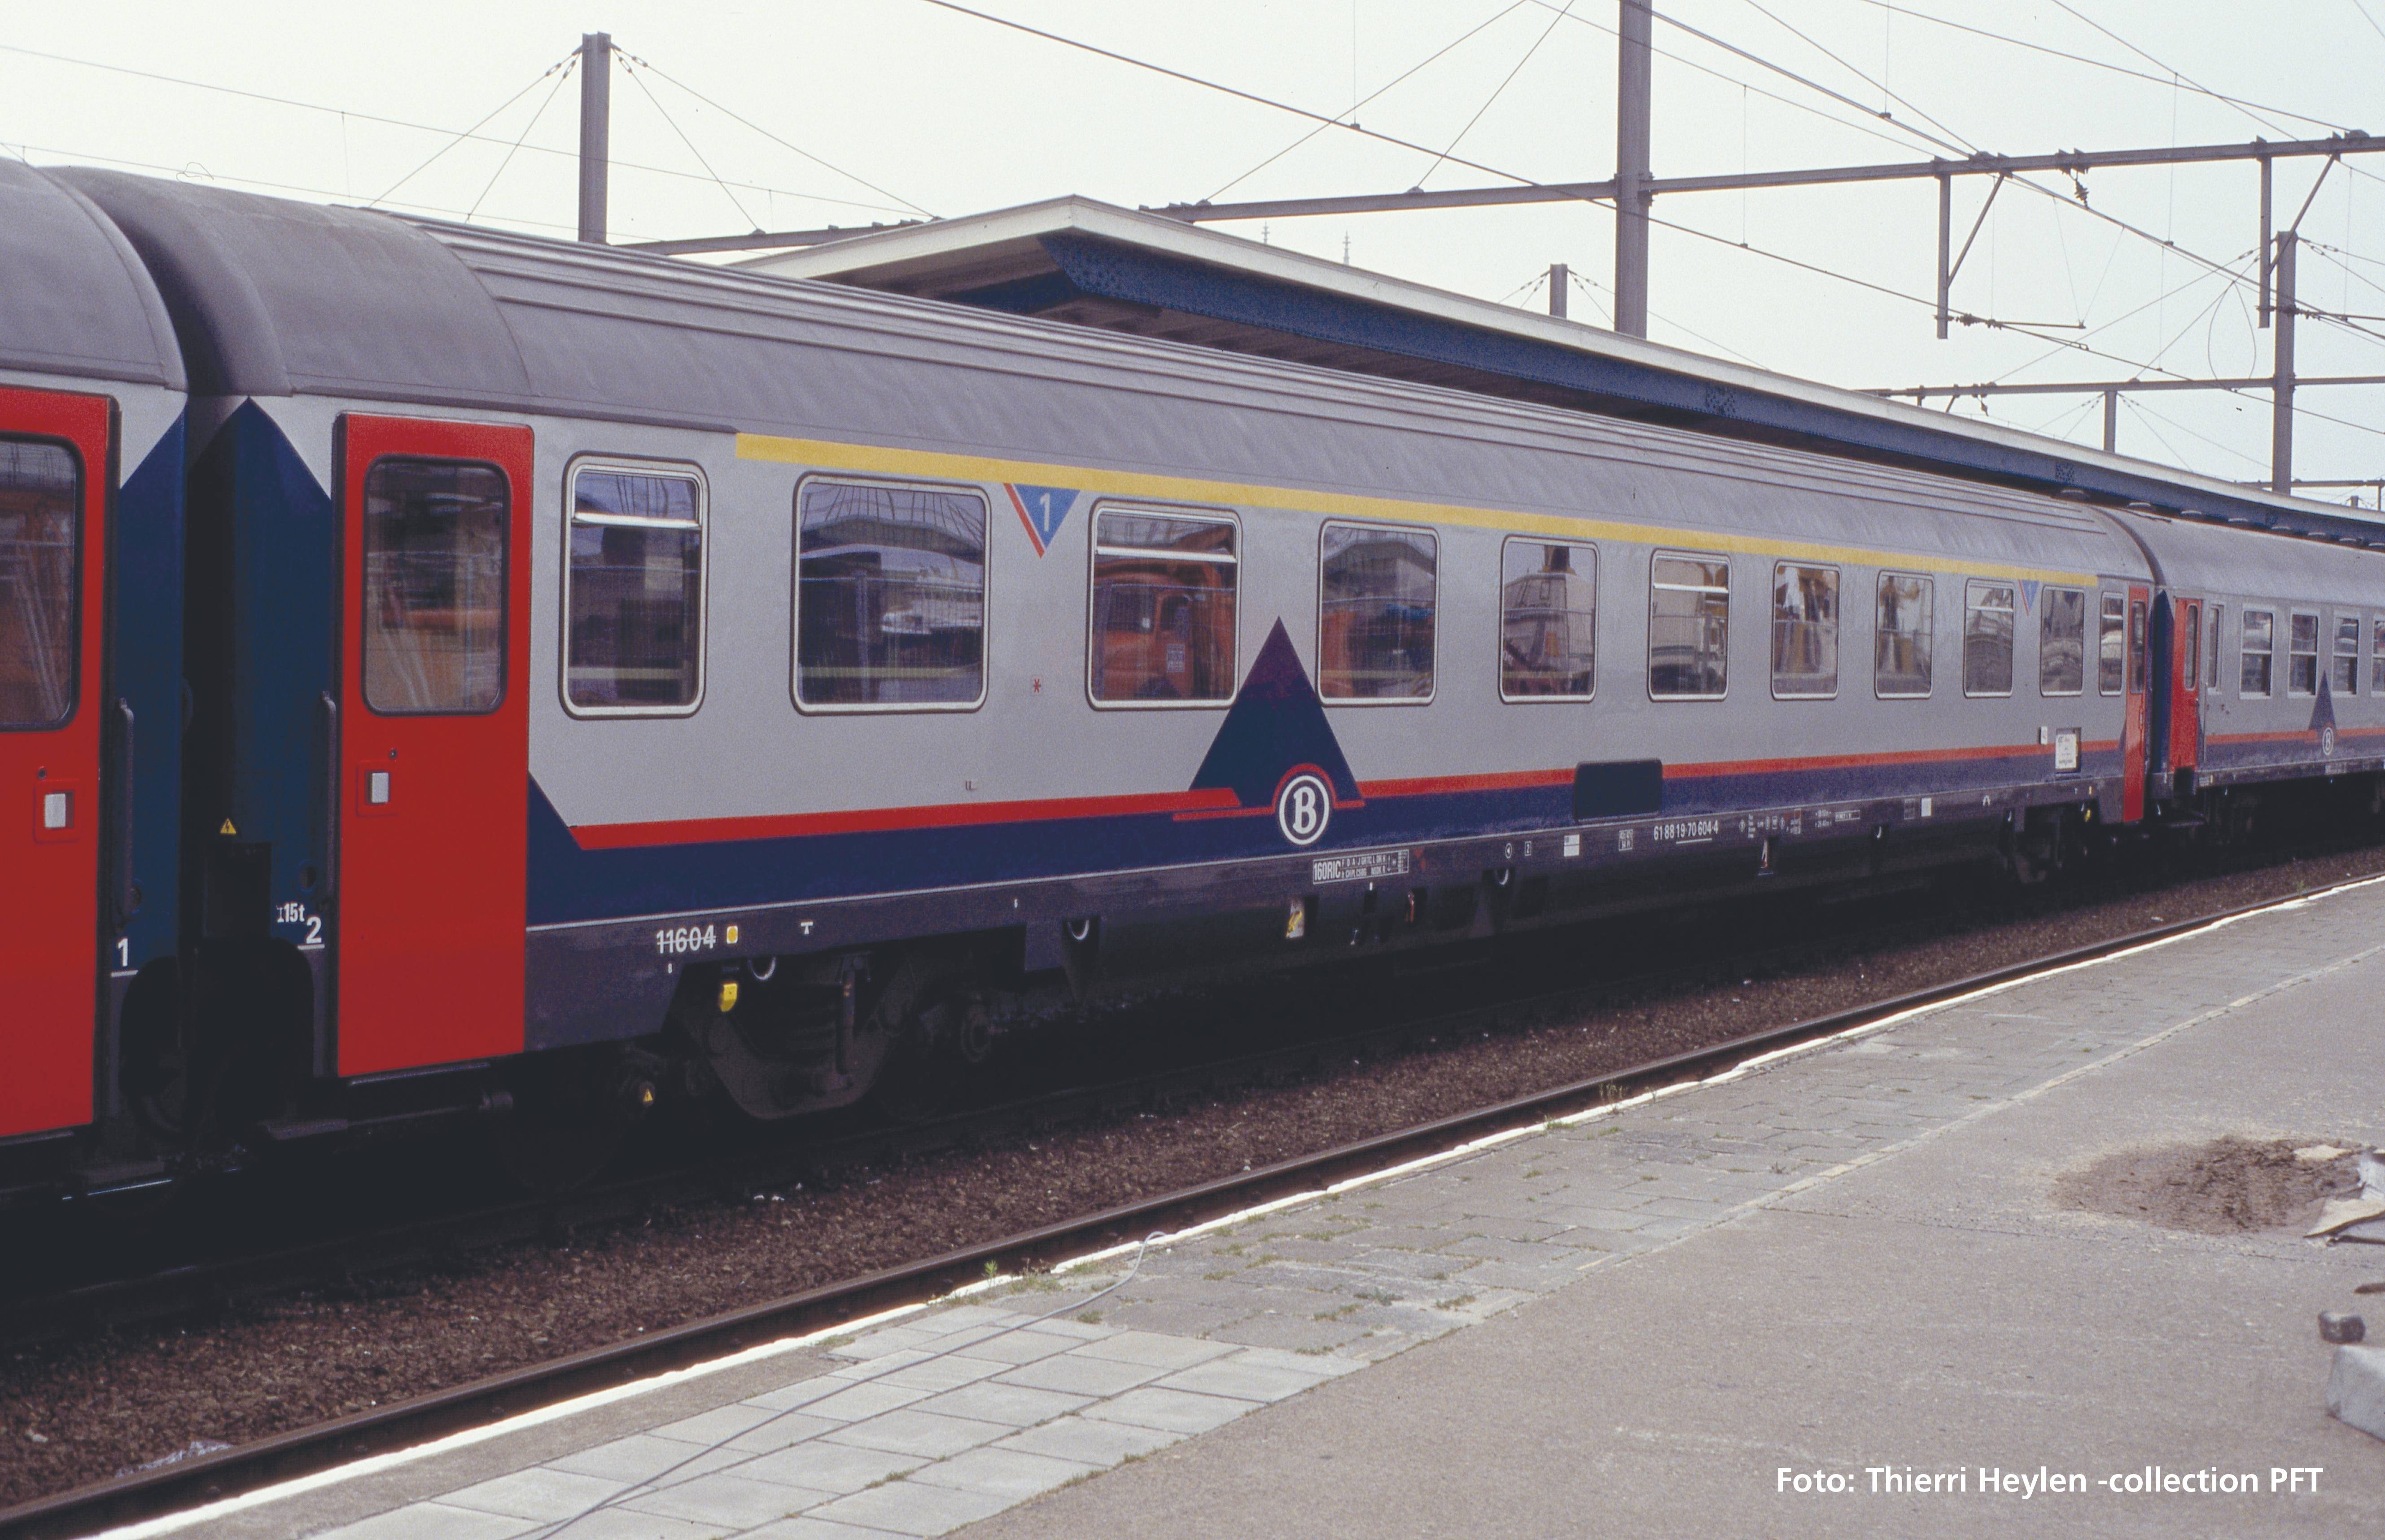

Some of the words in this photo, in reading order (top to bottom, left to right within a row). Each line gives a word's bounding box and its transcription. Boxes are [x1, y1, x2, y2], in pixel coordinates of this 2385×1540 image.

[1040, 493, 1050, 532] 1
[1292, 787, 1317, 834] B
[1654, 825, 1662, 840] 61
[1664, 824, 1674, 840] 88
[306, 916, 322, 944] 2
[656, 924, 717, 954] 11604
[118, 938, 128, 967] 1
[668, 963, 673, 974] 8
